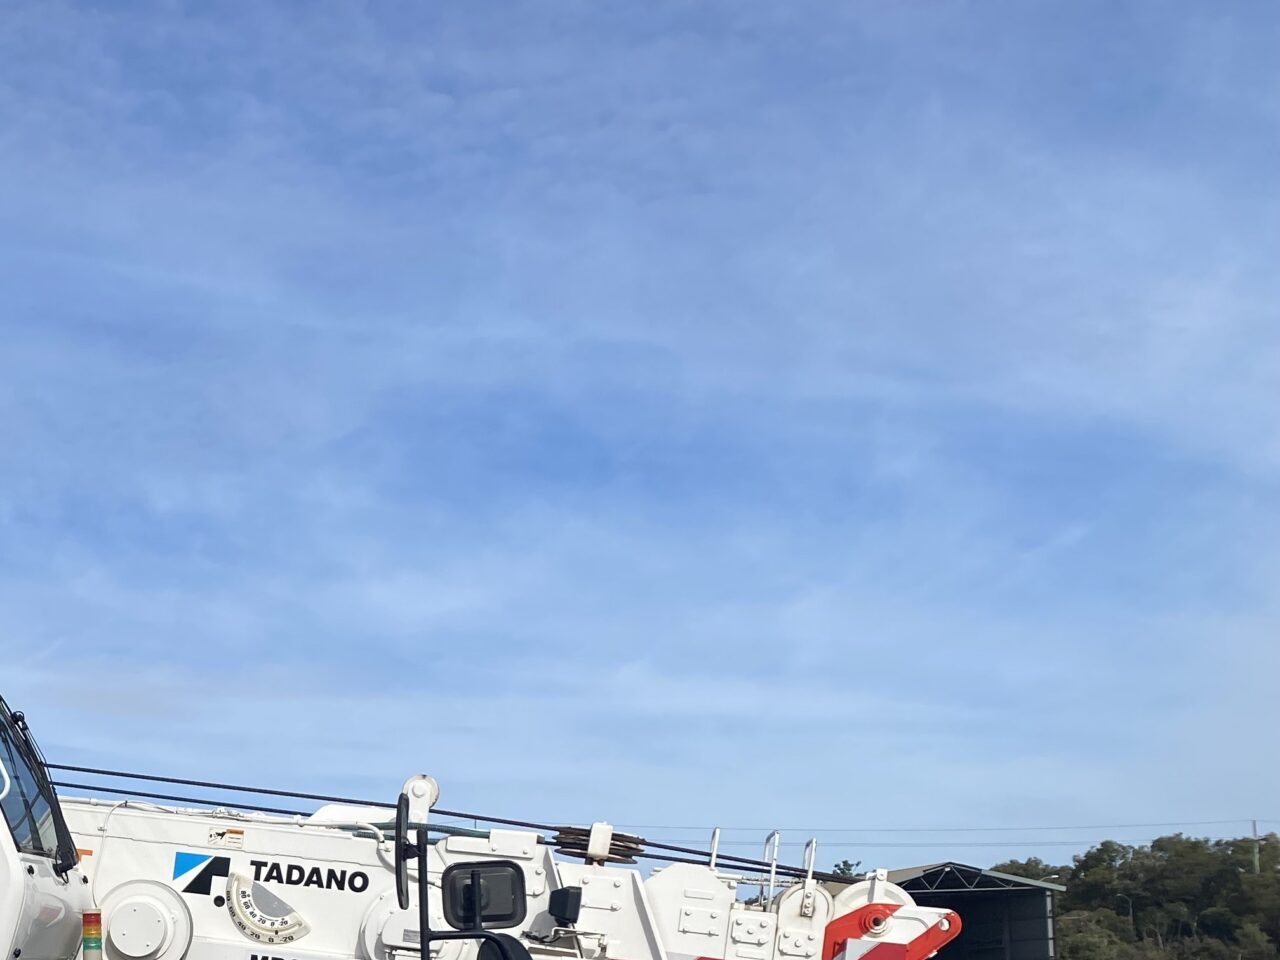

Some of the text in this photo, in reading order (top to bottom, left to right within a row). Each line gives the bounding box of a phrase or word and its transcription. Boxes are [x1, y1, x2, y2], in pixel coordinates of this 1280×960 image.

[250, 860, 370, 893] TADANO
[240, 890, 247, 899] 80
[242, 901, 251, 910] 60
[249, 910, 258, 919] 40
[250, 931, 261, 940] 20
